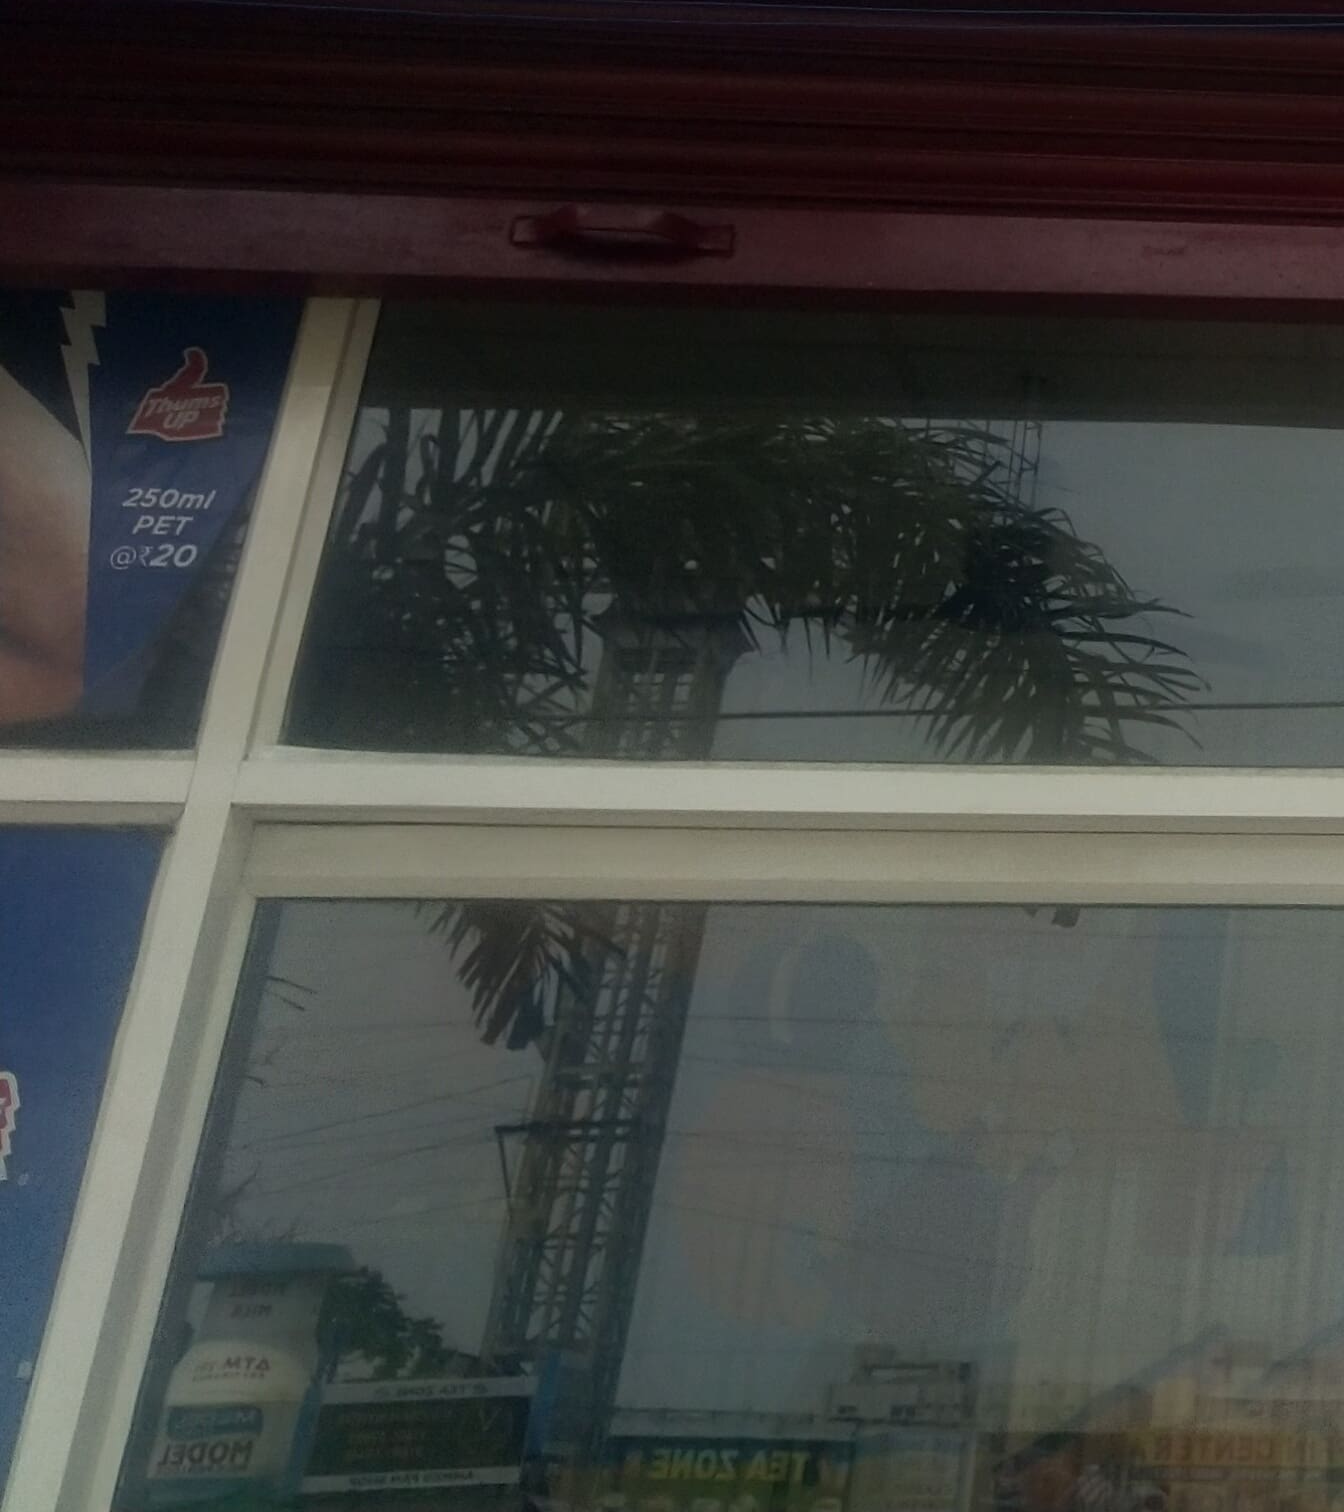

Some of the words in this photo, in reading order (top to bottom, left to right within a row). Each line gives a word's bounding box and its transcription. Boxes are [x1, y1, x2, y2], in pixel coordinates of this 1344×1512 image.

[148, 395, 221, 417] Thums
[163, 413, 200, 431] UP
[122, 488, 216, 509] 250ml
[132, 515, 193, 536] PET
[110, 544, 198, 570] @₹20
